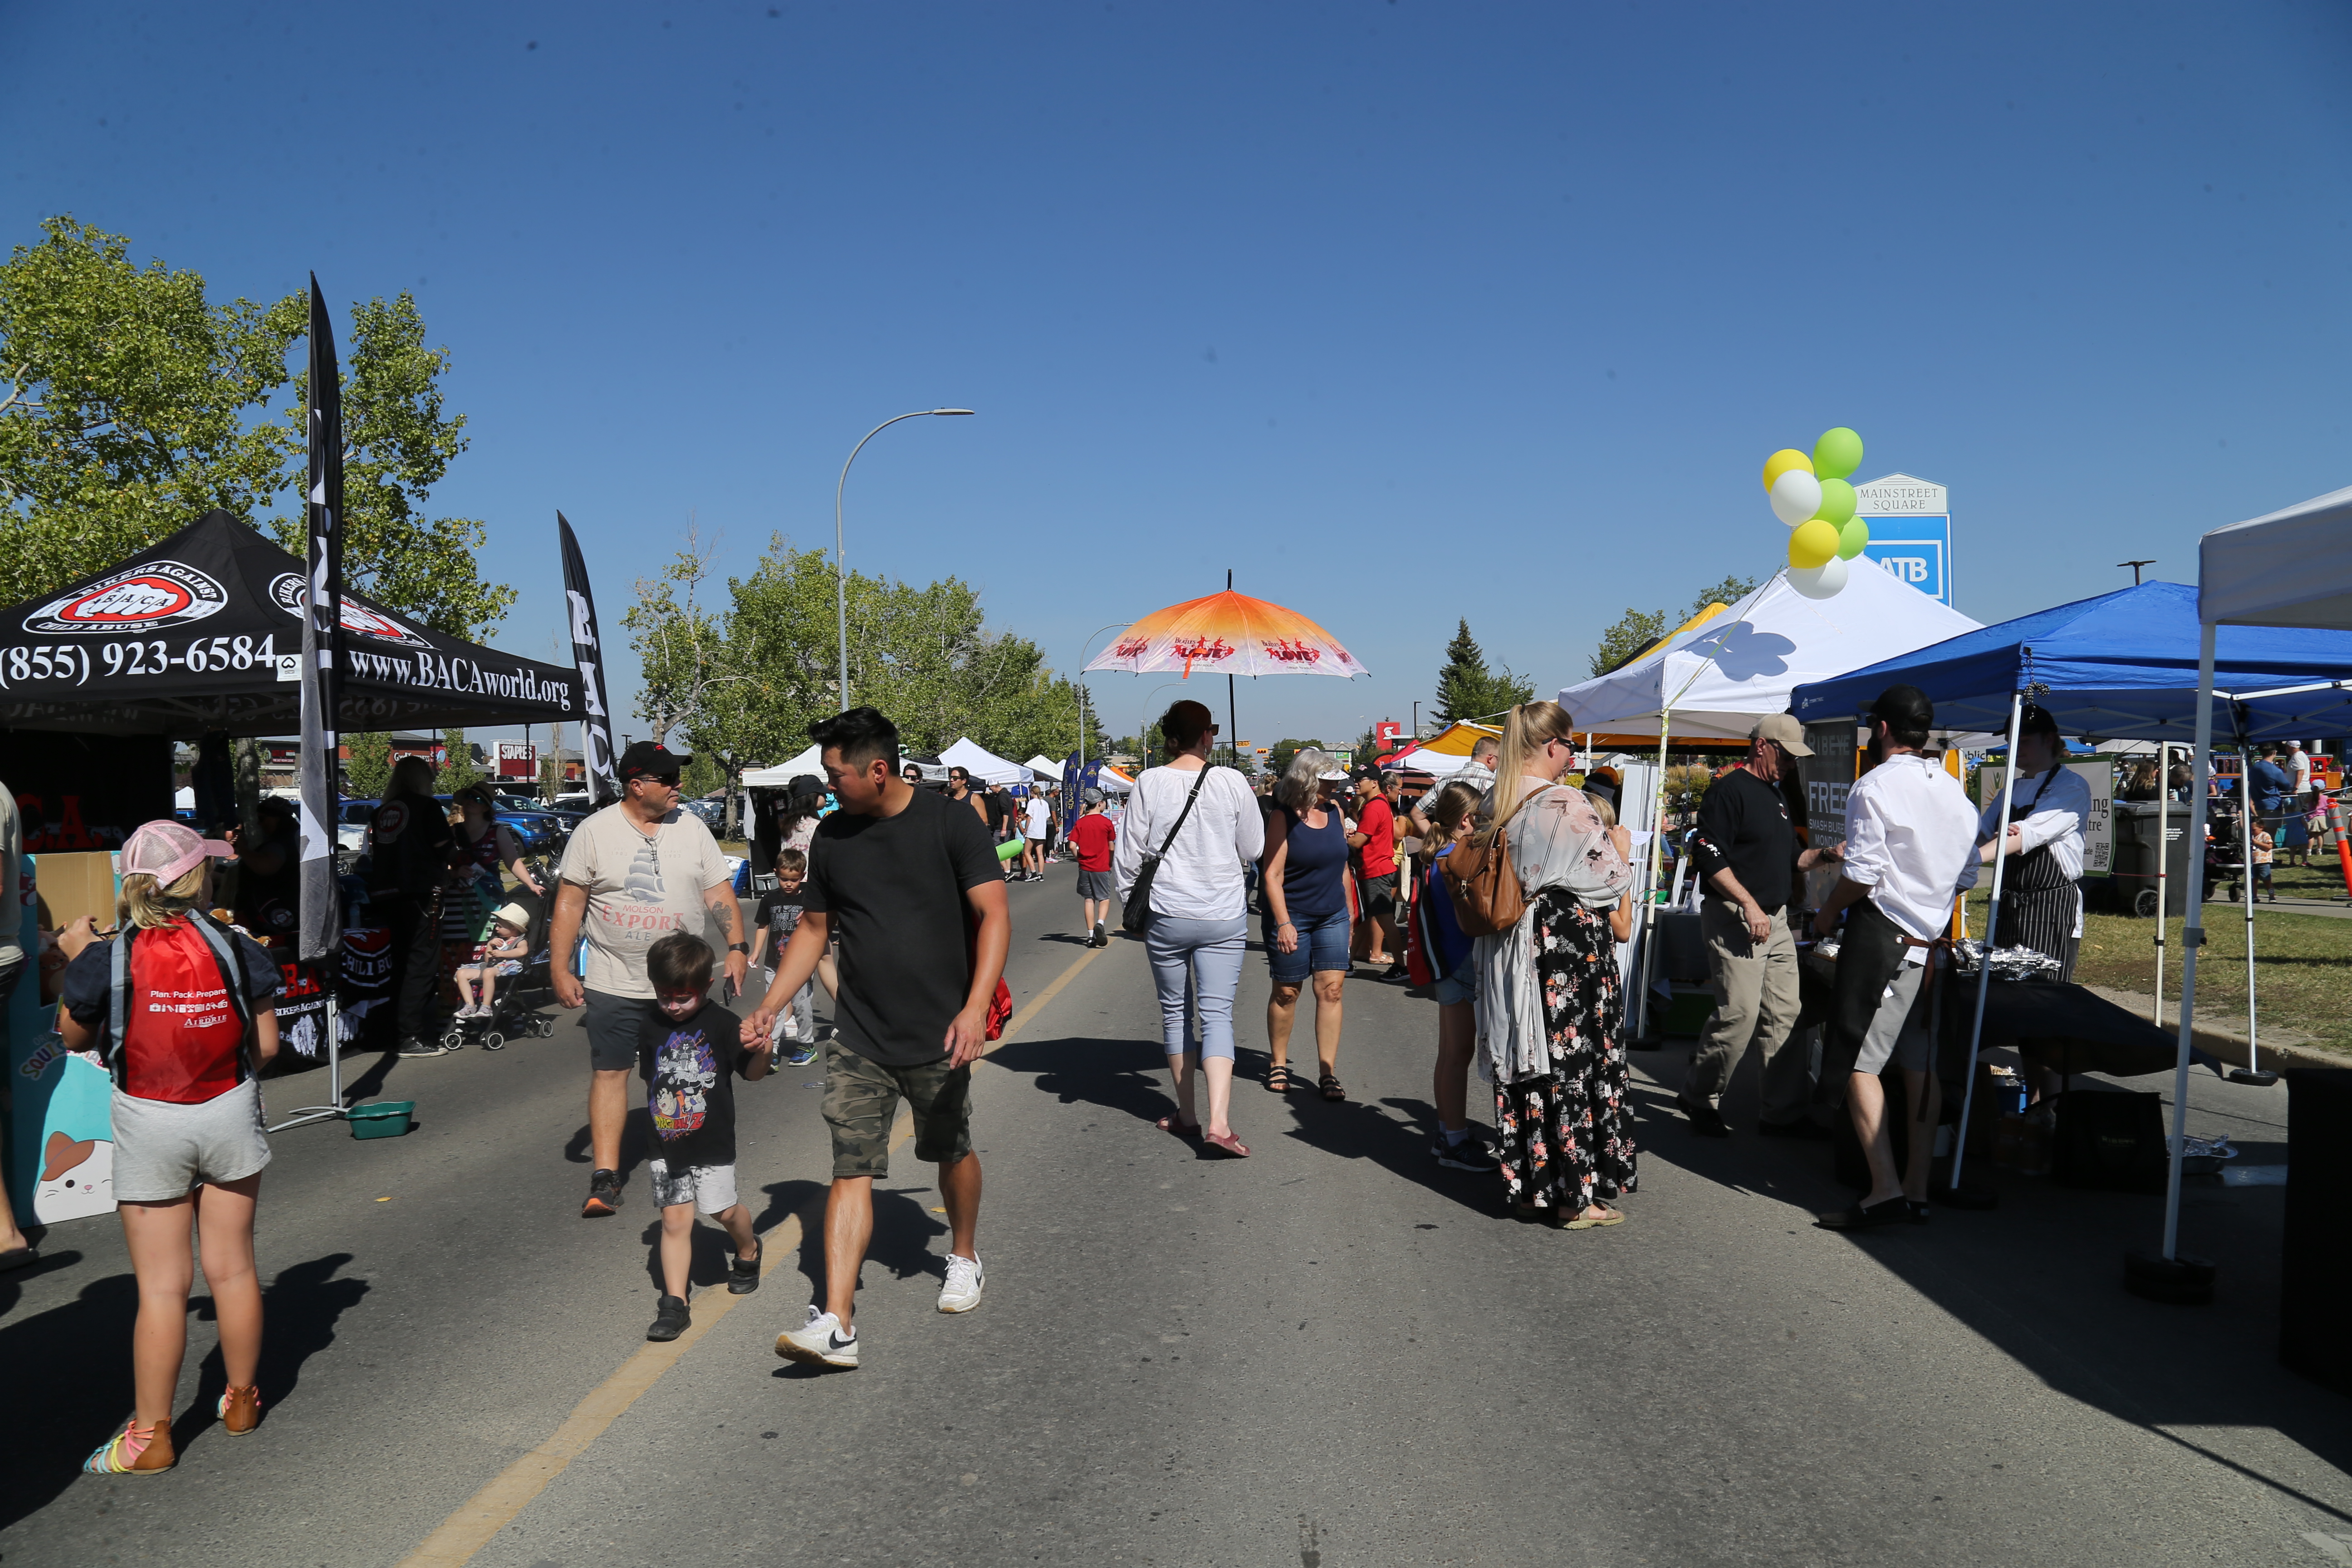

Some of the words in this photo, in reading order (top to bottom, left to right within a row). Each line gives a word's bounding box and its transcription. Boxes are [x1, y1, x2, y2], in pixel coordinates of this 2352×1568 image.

[1860, 488, 1938, 498] MAINSTREET
[1873, 500, 1926, 510] SQUARE
[1880, 557, 1928, 582] ATB
[79, 565, 158, 596] BIKERS
[157, 566, 217, 598] AGAINST
[279, 577, 305, 605] BIKERS
[103, 594, 169, 607] B.A.C.A.
[36, 622, 82, 630] CHILD
[83, 621, 158, 630] ABUSE
[0, 645, 90, 689] (855)
[103, 634, 276, 676] 923-6584
[349, 651, 570, 711] www.BACAworld.org
[1808, 732, 1850, 755] RIBEYE
[501, 745, 532, 760] STAPLES
[1808, 781, 1850, 815] FREE
[1809, 818, 1828, 832] SMASH
[603, 905, 684, 931] EXPORT
[623, 905, 663, 914] MOLSON
[625, 931, 651, 941] ALE
[184, 1015, 227, 1025] AIRDRIE
[688, 1111, 707, 1130] Z
